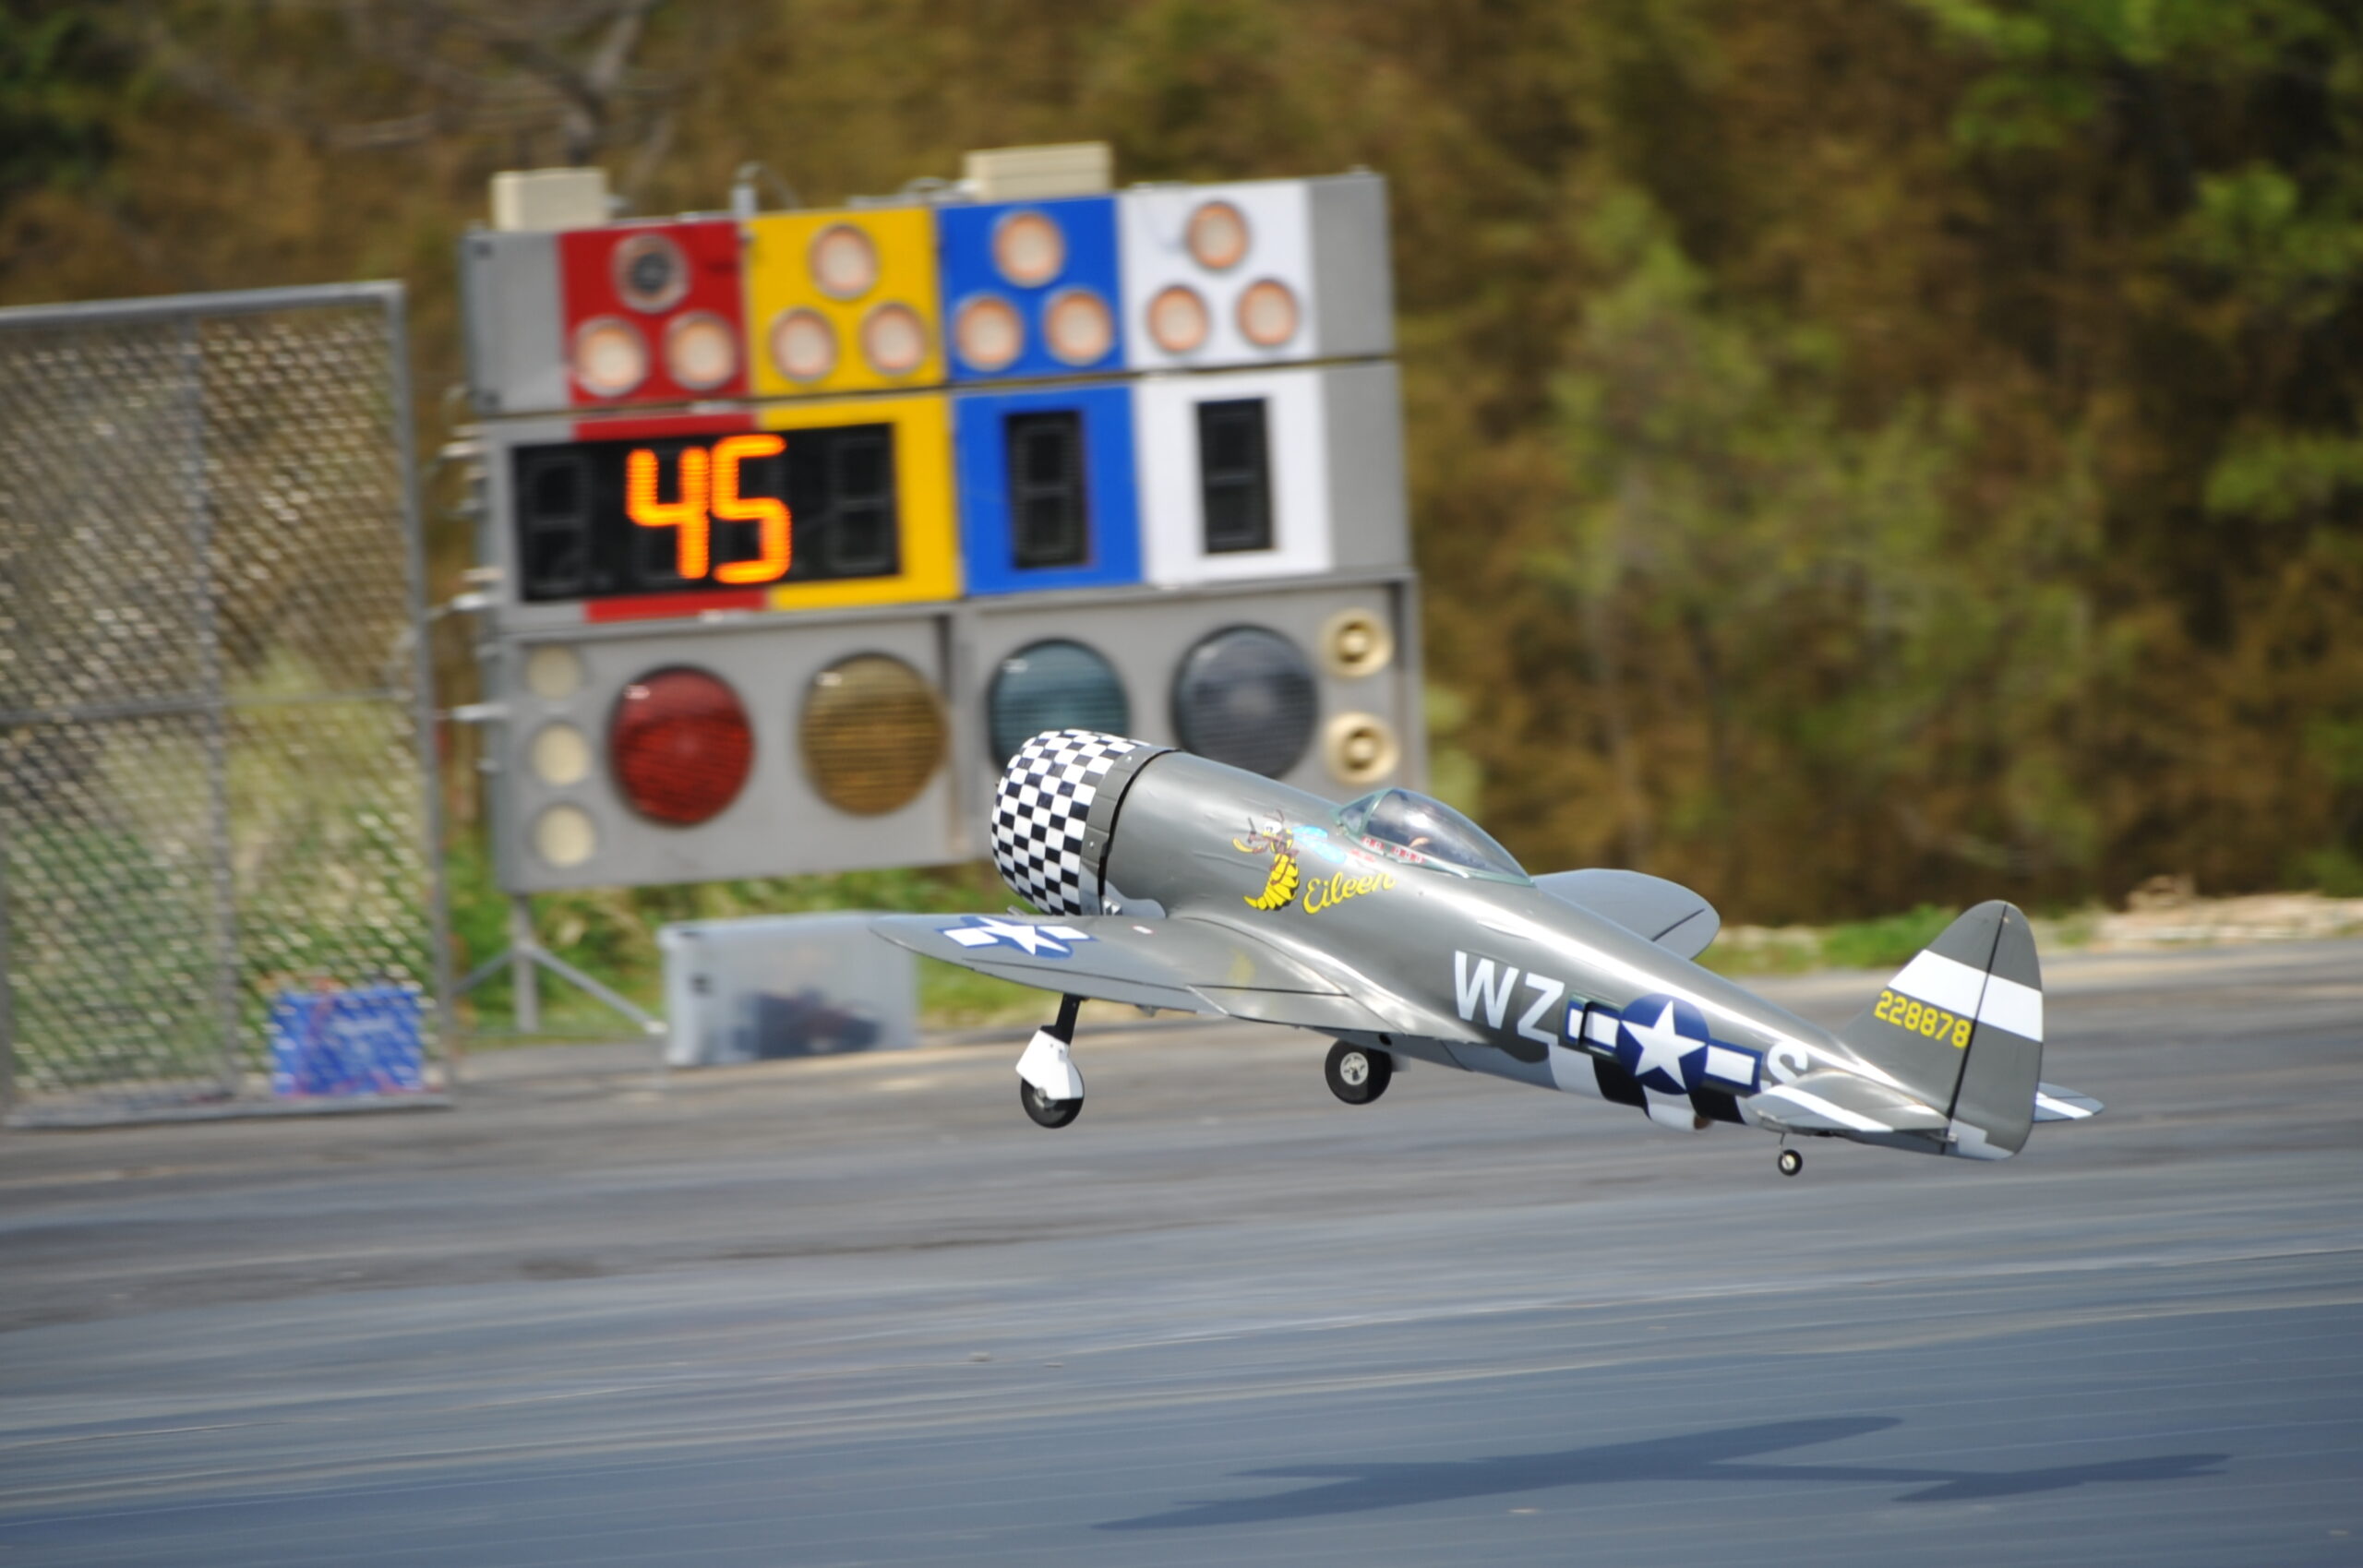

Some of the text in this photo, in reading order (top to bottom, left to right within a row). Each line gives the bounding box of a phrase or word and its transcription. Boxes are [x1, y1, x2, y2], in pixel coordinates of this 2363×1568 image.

[626, 434, 792, 584] 45
[1302, 871, 1397, 915] Eileen
[1455, 950, 1565, 1045] WZ
[1873, 990, 1973, 1048] 228878
